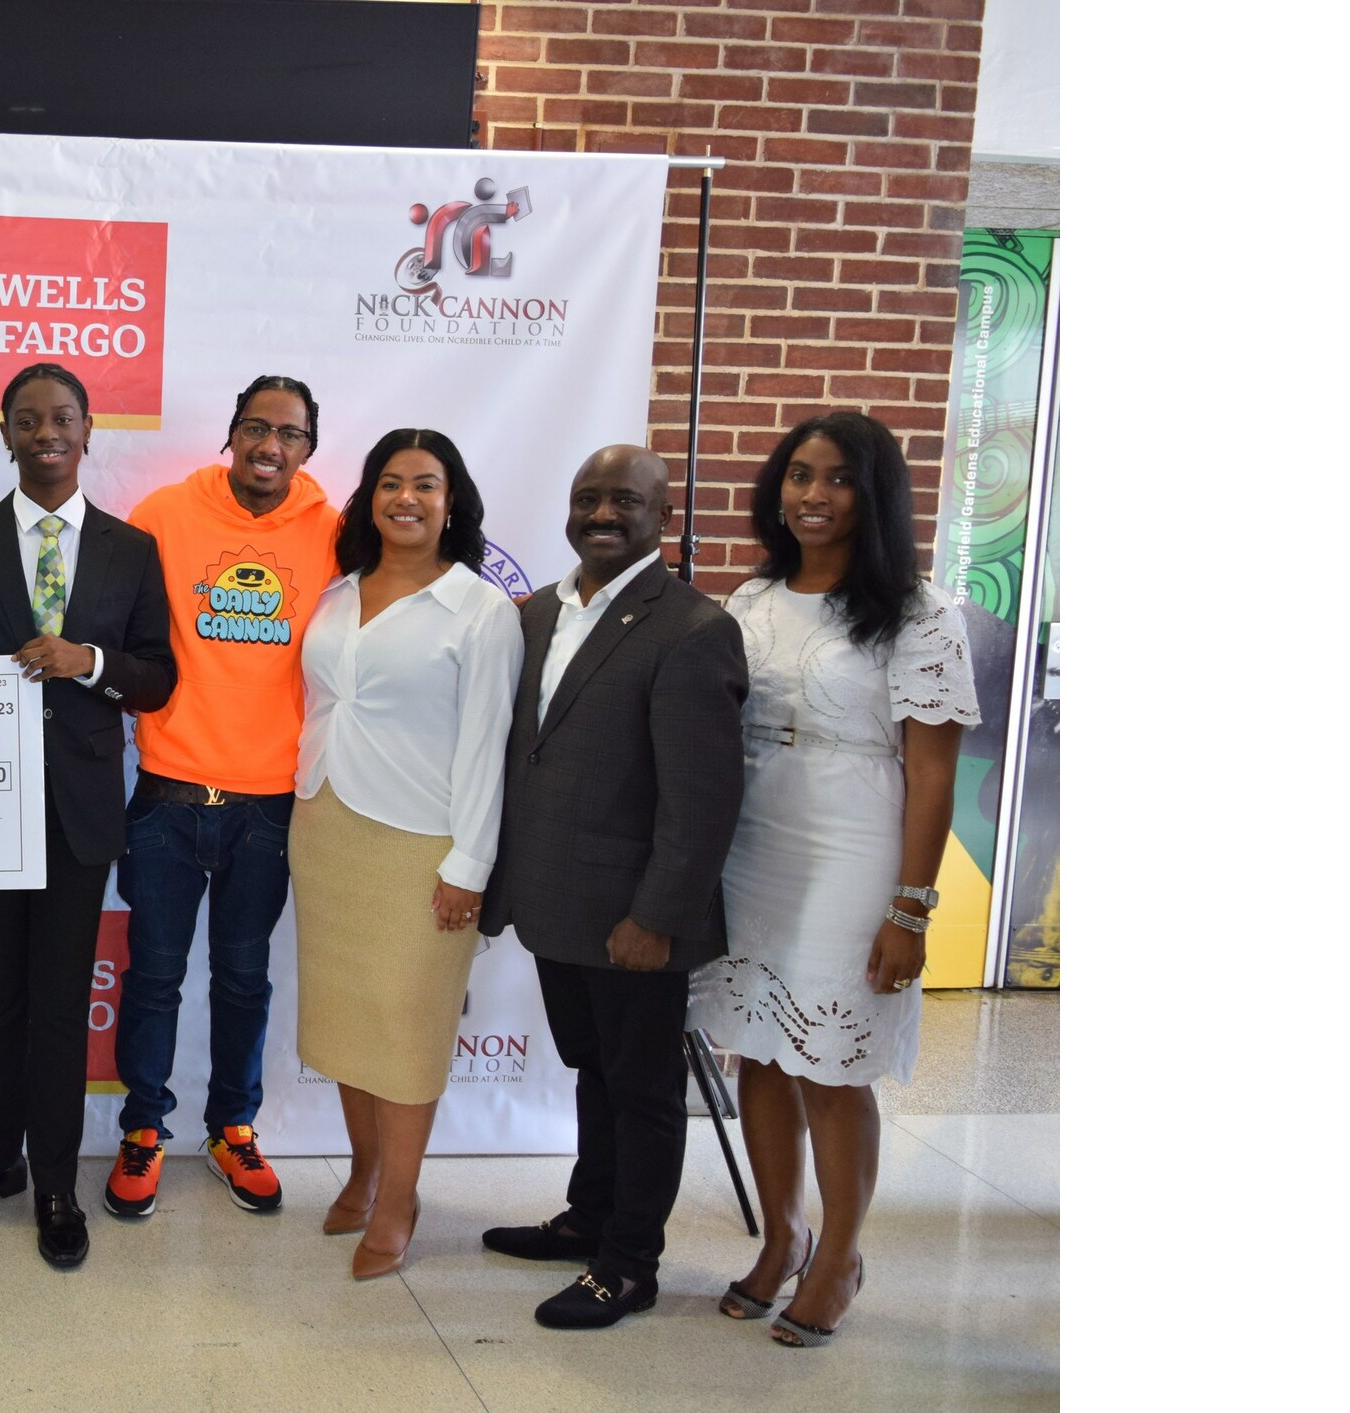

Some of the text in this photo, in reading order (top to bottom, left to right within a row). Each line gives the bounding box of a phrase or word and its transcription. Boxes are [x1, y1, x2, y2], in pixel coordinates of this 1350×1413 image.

[438, 296, 569, 321] CANNON
[355, 317, 565, 337] FOUNDATION
[953, 286, 994, 606] Springfield Gardens Educational Campus
[193, 582, 210, 594] The
[209, 586, 281, 617] DAILY
[196, 612, 291, 646] CANNON
[455, 1034, 529, 1057] NON
[502, 1075, 523, 1083] TIME
